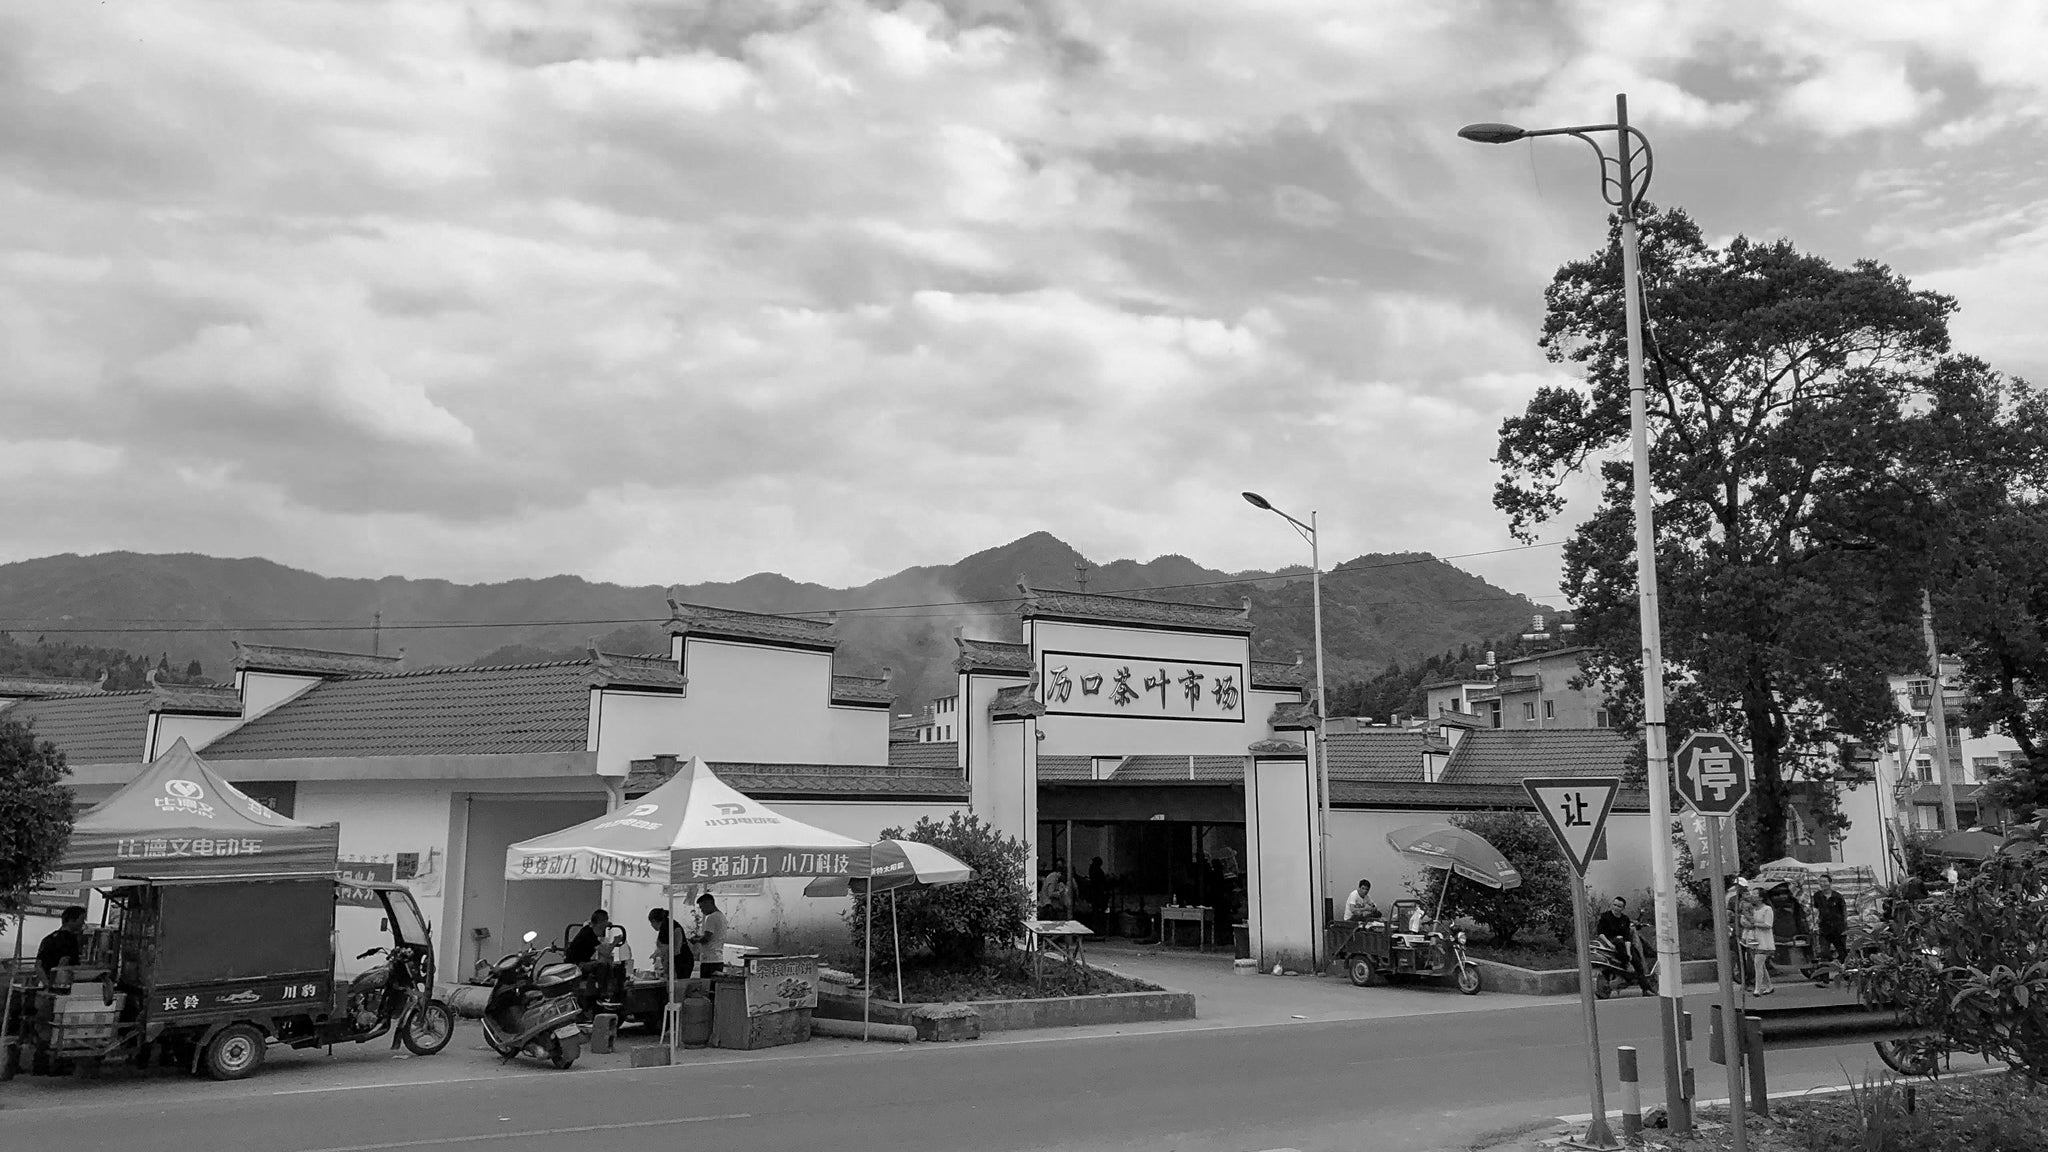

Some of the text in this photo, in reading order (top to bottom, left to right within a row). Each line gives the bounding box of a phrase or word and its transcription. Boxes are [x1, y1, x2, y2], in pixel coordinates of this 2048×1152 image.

[1046, 665, 1239, 711] 历口茶叶市场
[1687, 746, 1737, 801] 停
[1561, 792, 1591, 827] 让
[117, 838, 263, 857] 比德文电动车
[521, 854, 651, 879] 更强动力 小刀科技
[690, 853, 850, 878] 更强动力 小刀科技
[282, 984, 316, 999] 川豹
